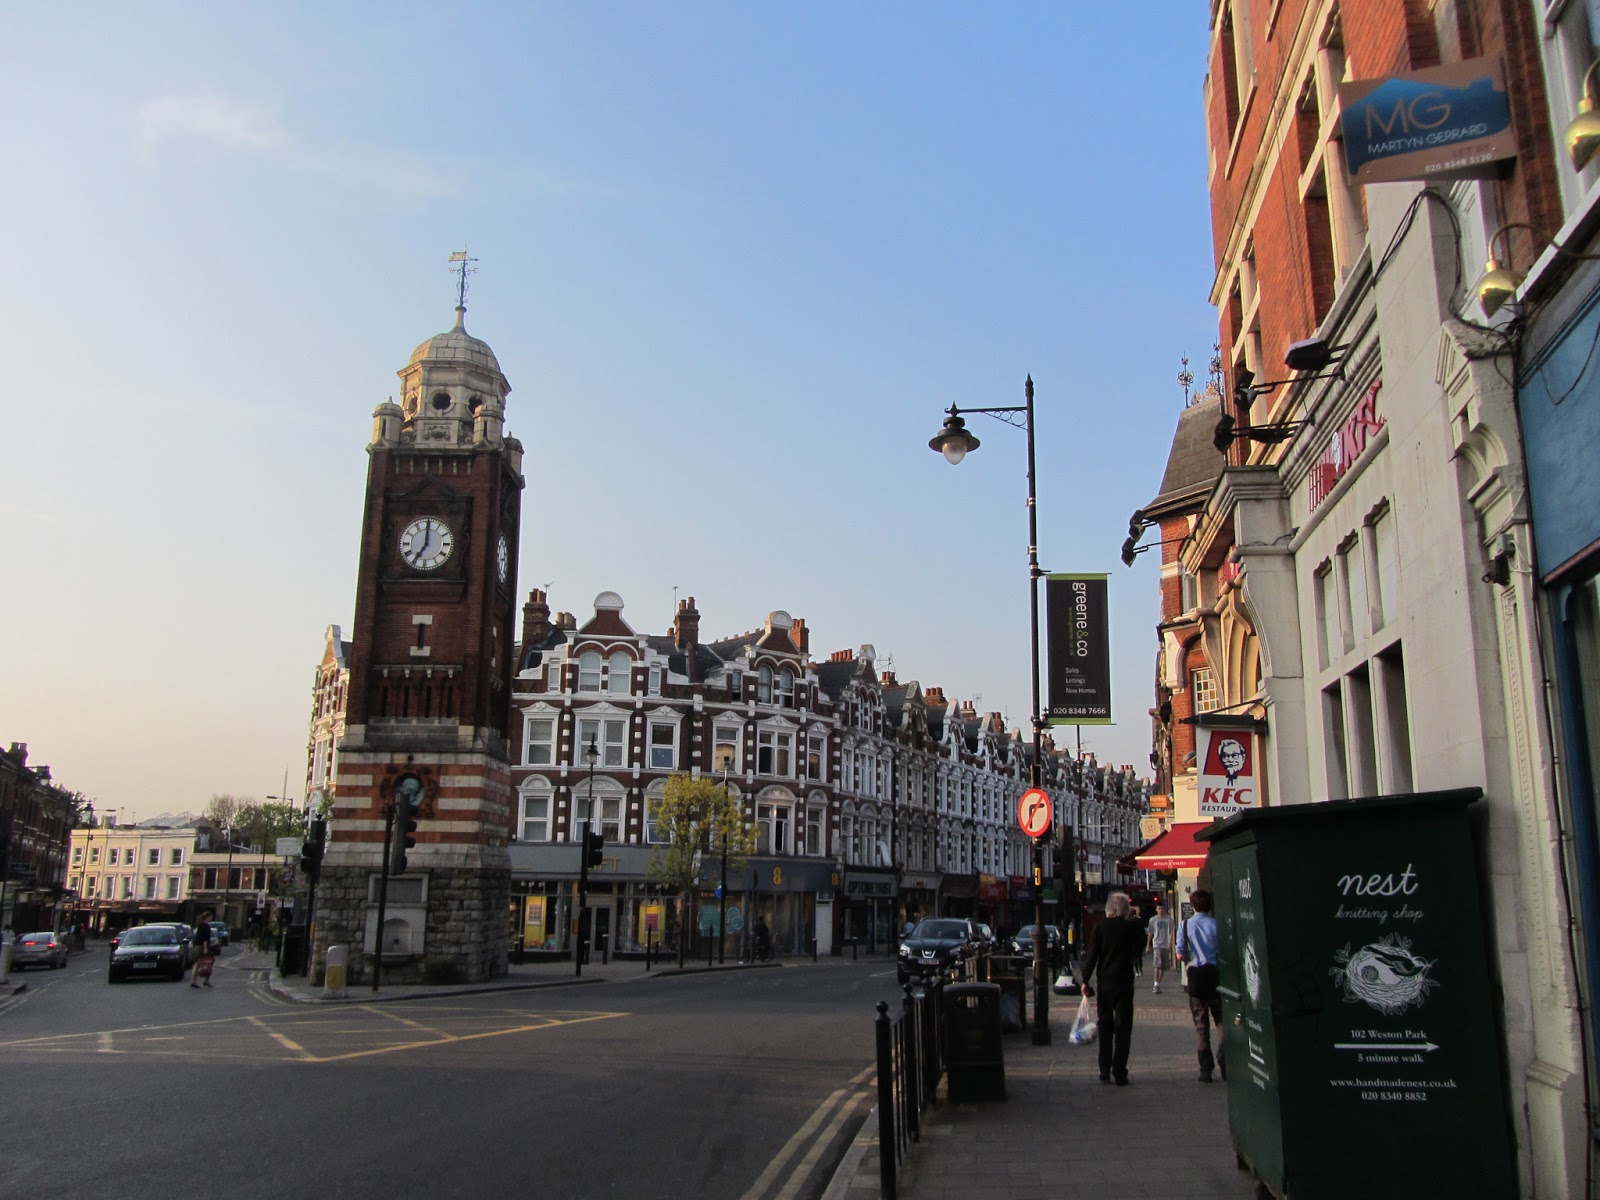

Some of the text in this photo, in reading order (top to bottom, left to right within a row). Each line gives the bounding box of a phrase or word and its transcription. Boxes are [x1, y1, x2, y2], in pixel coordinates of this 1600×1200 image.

[1366, 92, 1452, 139] MG
[1367, 122, 1488, 154] MARTYN GERRARD
[1424, 163, 1442, 173] 020
[1072, 582, 1088, 657] greene & co
[1065, 677, 1085, 685] Lettings
[1068, 707, 1086, 715] 8348
[1088, 707, 1106, 715] 7666
[1202, 787, 1252, 805] KFC
[1201, 805, 1249, 813] RESTAURA
[1337, 863, 1418, 896] nest
[1334, 904, 1424, 924] knitting shop
[1351, 1029, 1427, 1039] 102 Weston Park
[1358, 1053, 1424, 1063] 5 minute walk
[1329, 1078, 1457, 1088] www.handmadenest.co.uk
[1361, 1091, 1427, 1101] 020 8340 8852
